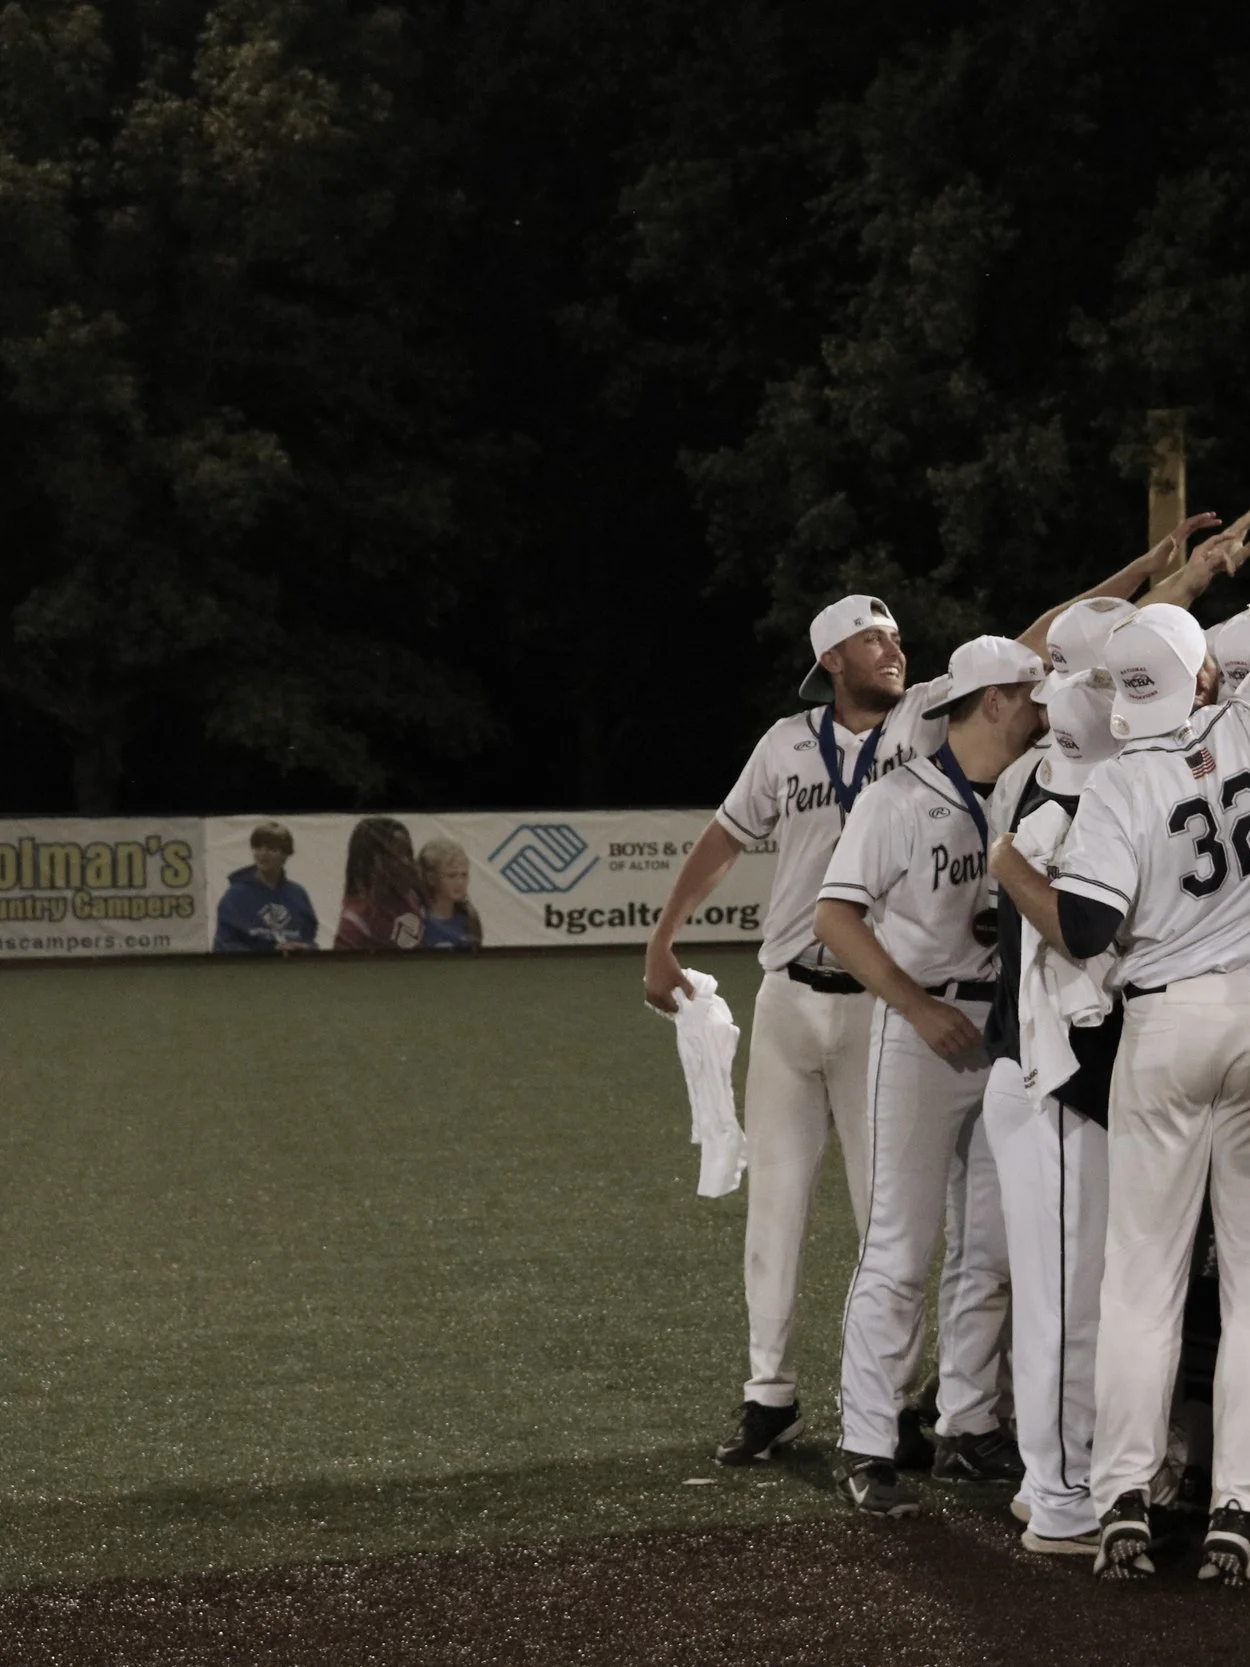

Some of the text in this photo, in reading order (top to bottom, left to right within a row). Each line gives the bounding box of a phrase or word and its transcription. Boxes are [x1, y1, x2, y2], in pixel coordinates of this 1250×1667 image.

[1120, 675, 1156, 689] NCBA
[608, 841, 659, 857] BOYS
[662, 842, 678, 856] &
[608, 859, 671, 872] OF ALTON
[73, 888, 194, 920] Campers
[544, 901, 761, 935] bgcalt.org
[0, 933, 171, 952] scampers.com
